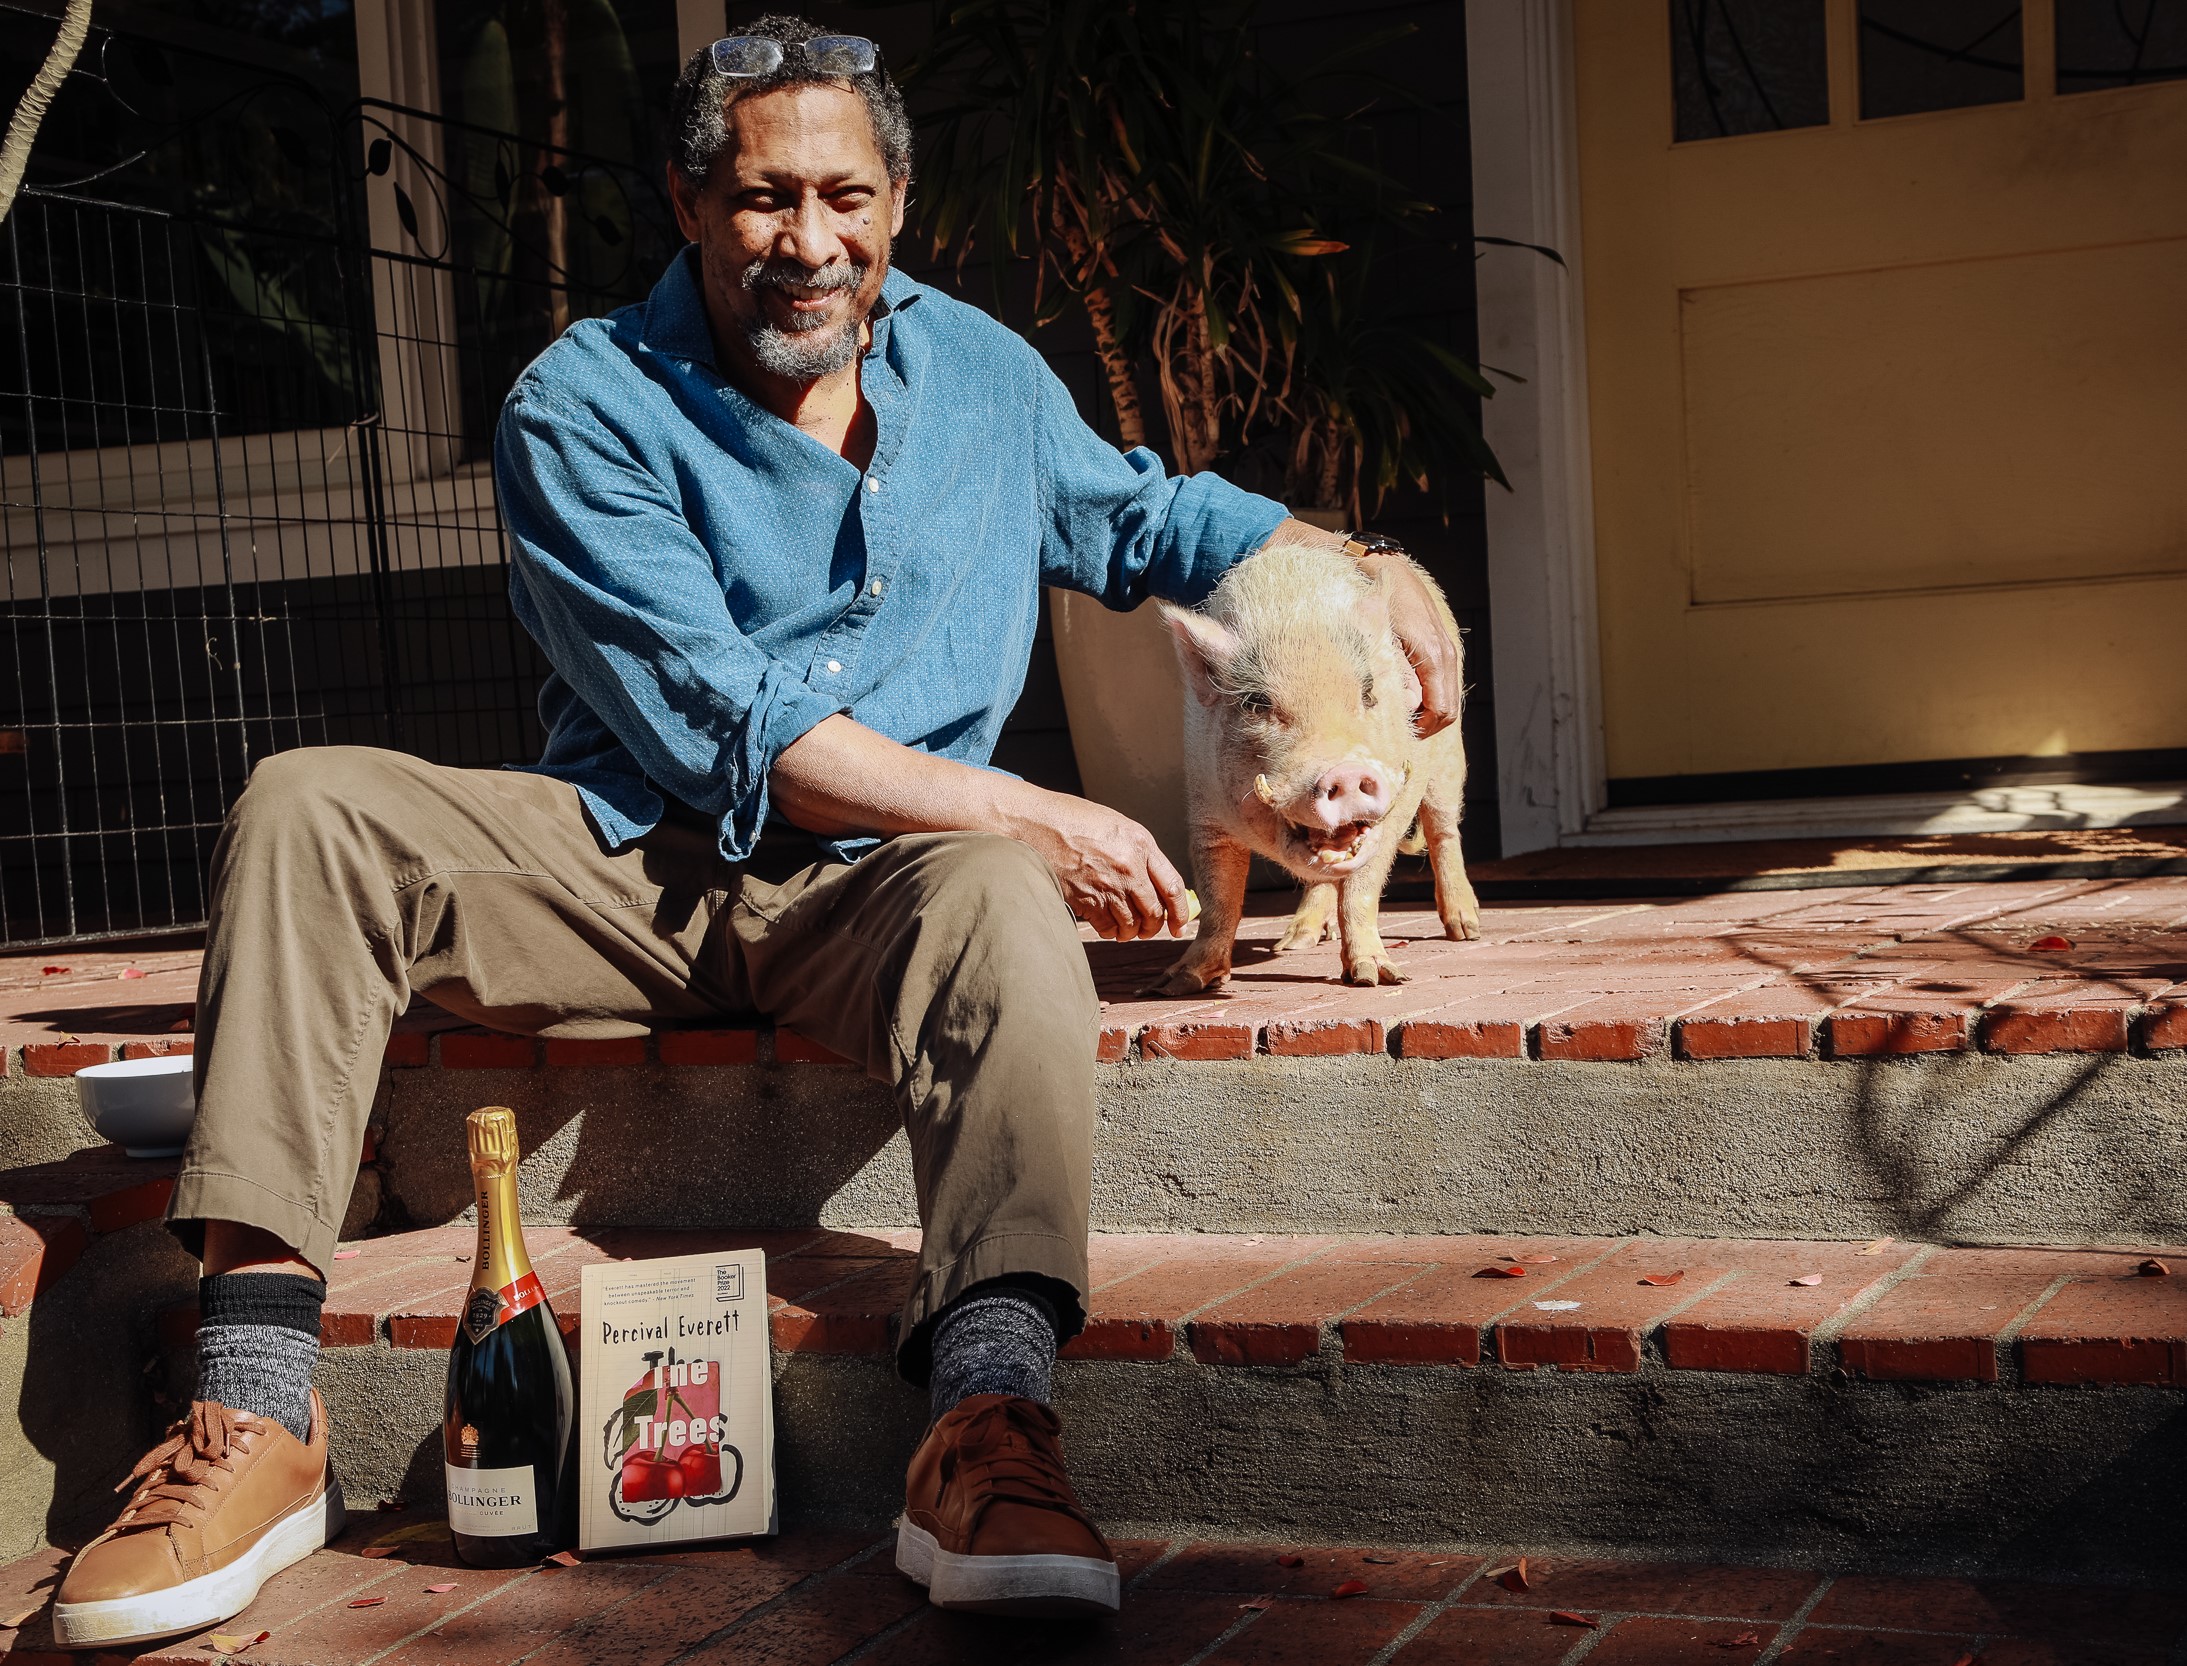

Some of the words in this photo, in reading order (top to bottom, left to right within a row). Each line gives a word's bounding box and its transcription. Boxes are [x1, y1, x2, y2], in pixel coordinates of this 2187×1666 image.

[481, 1191, 490, 1270] BOLLINGER
[631, 1288, 664, 1297] unspeakable
[603, 1316, 668, 1344] Percival
[679, 1309, 739, 1337] Everett
[641, 1346, 708, 1389] The
[634, 1412, 728, 1449] Trees
[448, 1490, 522, 1507] BOLLINGER
